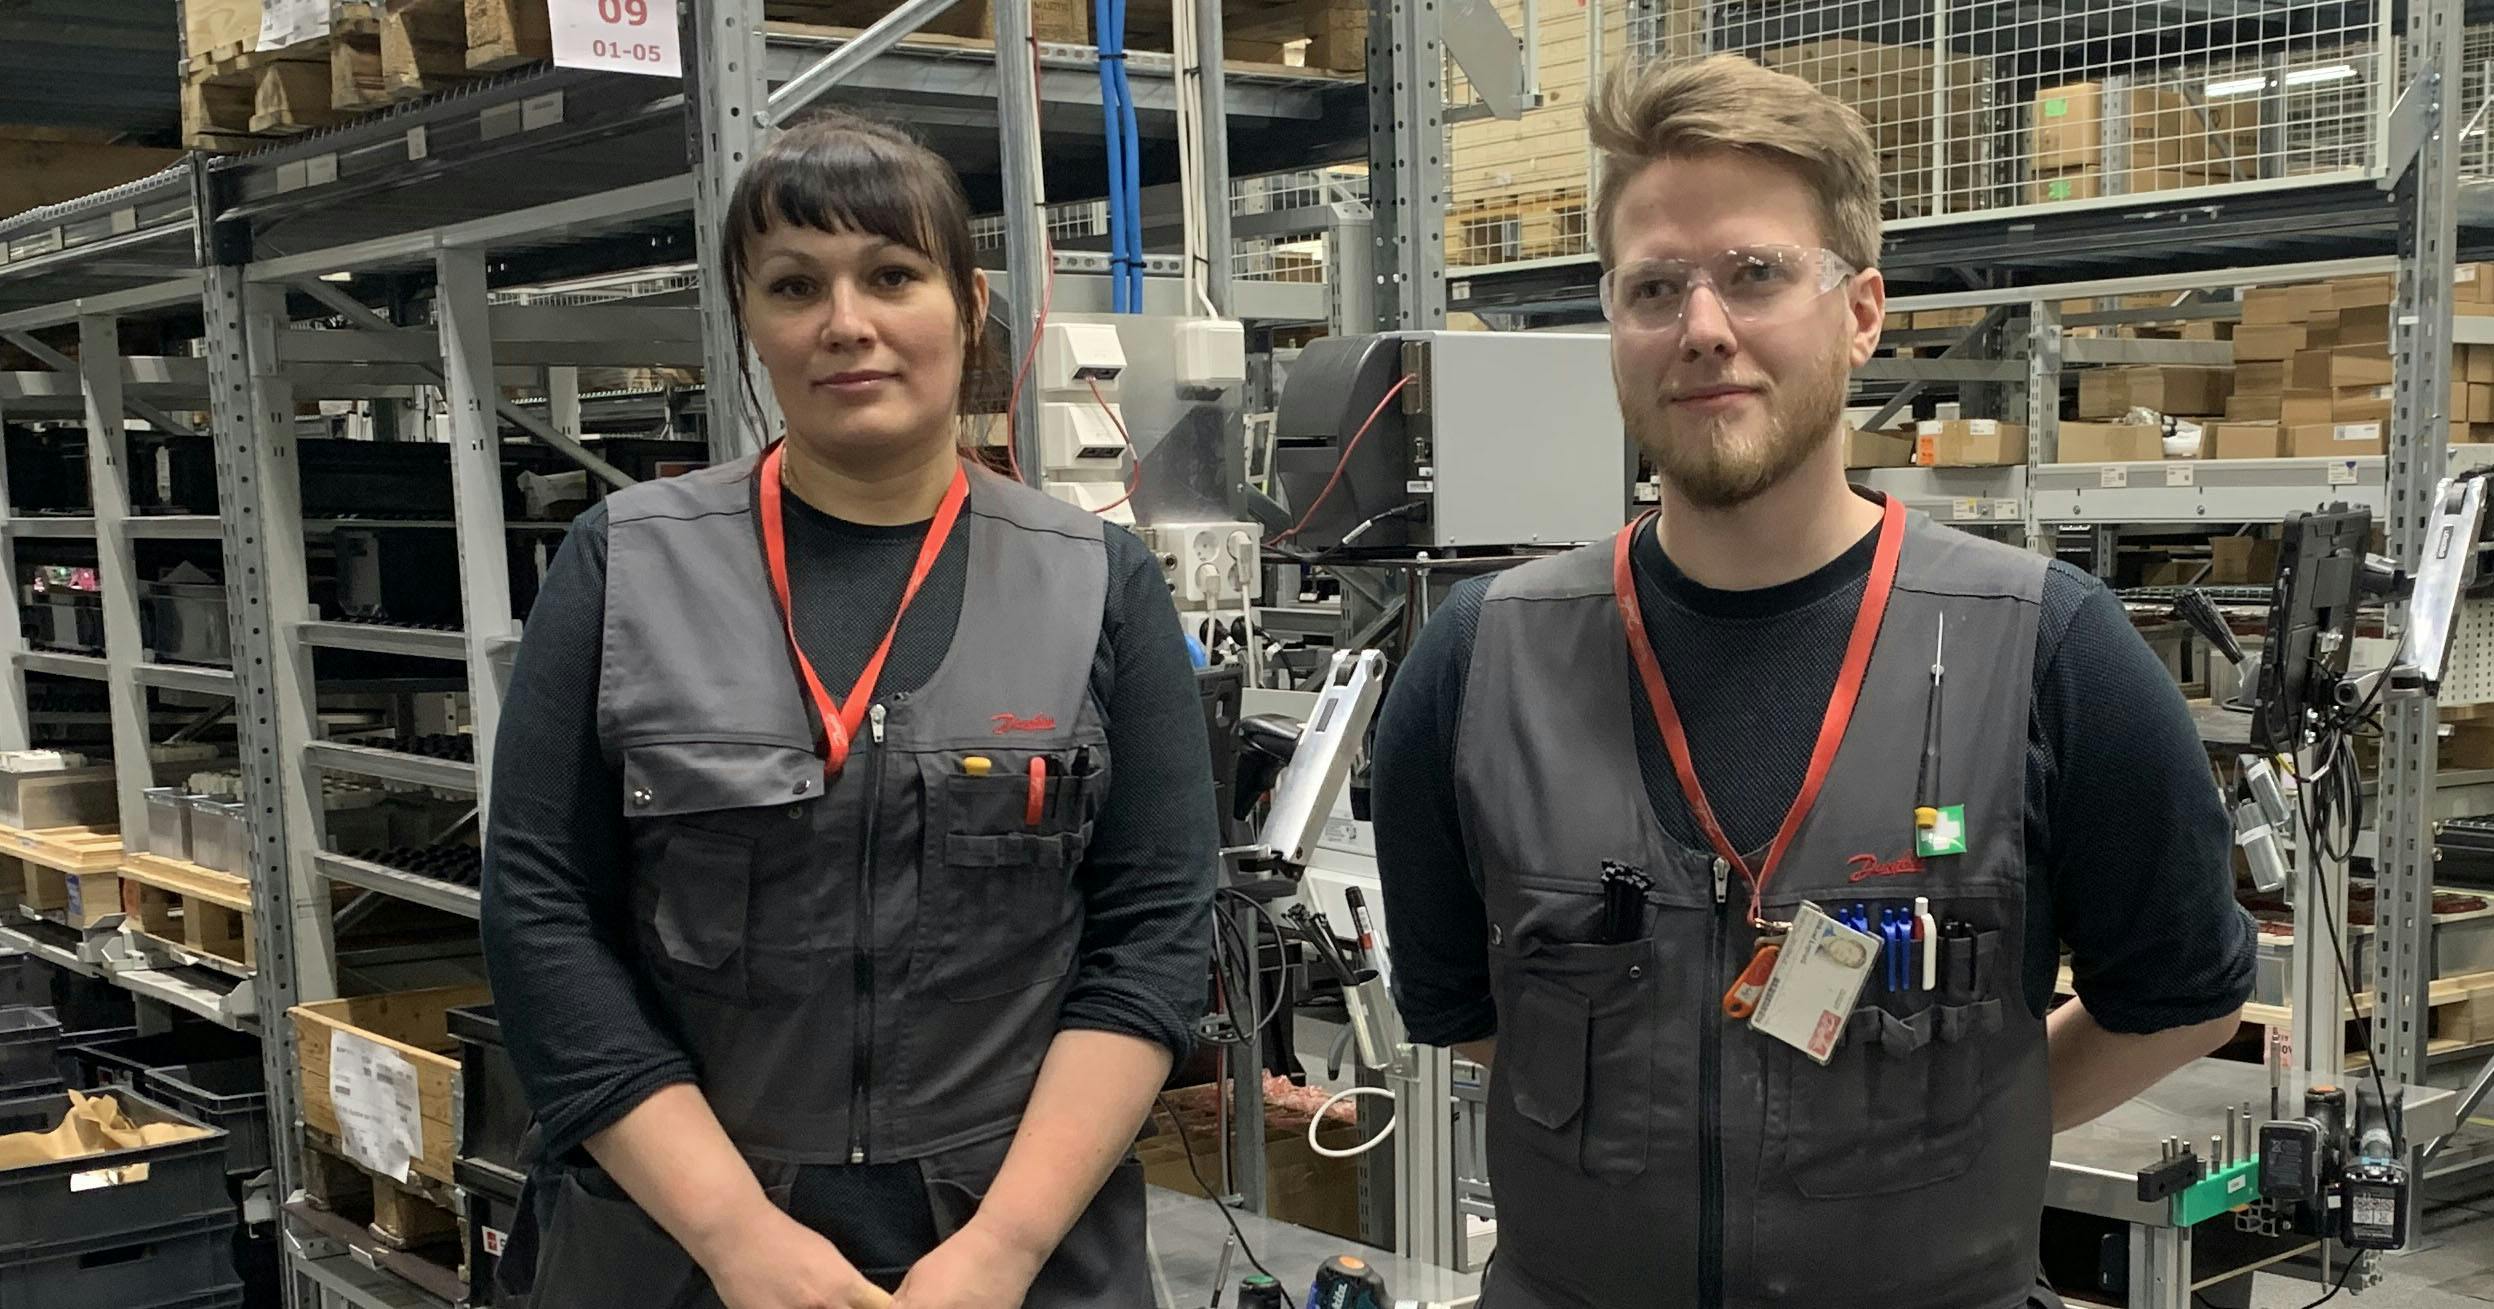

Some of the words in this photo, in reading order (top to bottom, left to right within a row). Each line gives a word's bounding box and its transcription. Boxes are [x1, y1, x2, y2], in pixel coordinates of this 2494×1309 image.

[598, 0, 648, 26] 09
[592, 39, 662, 62] 01-05
[1331, 1282, 1349, 1309] kita
